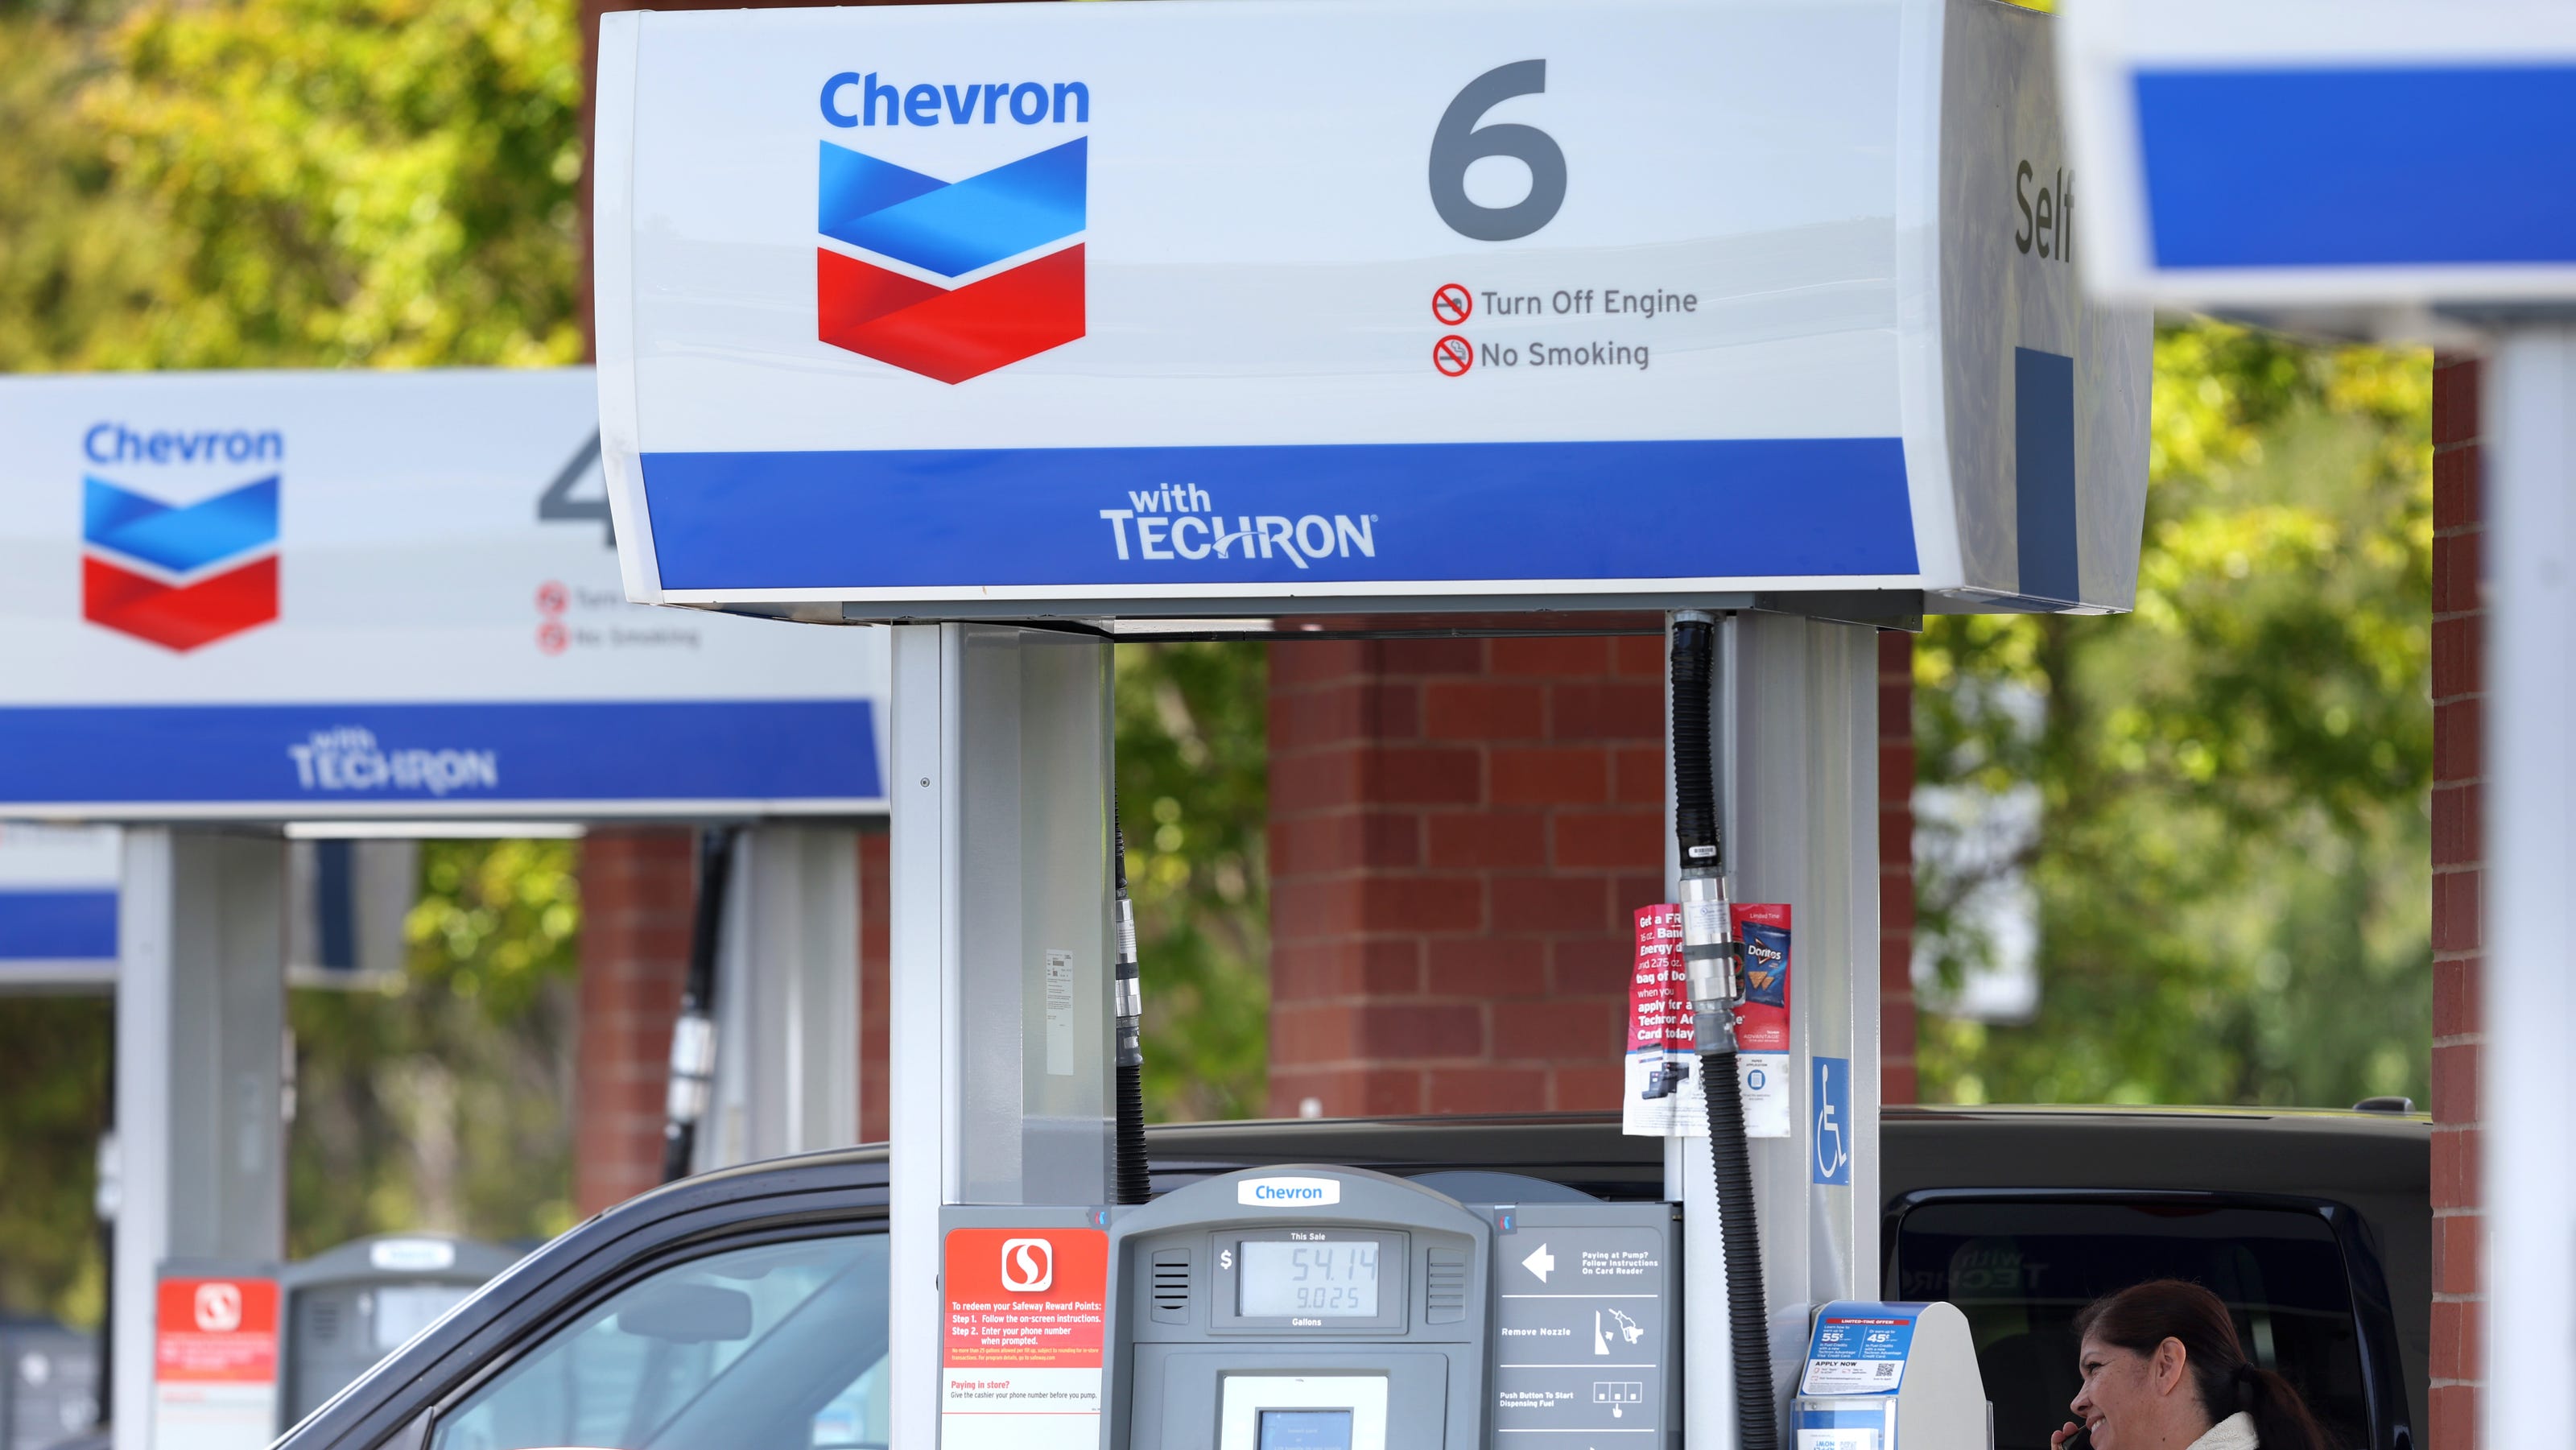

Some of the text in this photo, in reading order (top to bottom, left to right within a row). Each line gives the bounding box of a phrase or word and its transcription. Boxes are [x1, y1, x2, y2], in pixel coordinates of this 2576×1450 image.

[819, 71, 1089, 128] Chevron
[1429, 59, 1567, 242] 6
[2015, 159, 2076, 263] Self
[1481, 289, 1698, 318] Turn Off Engine
[1481, 341, 1649, 370] No Smoking
[82, 421, 284, 466] Chevron
[1128, 483, 1212, 513] with
[312, 725, 376, 751] with
[290, 745, 498, 796] TECHRON
[1640, 915, 1652, 927] Get
[1654, 915, 1662, 924] a
[1640, 944, 1673, 957] Energy
[1748, 945, 1781, 960] Doritos
[1651, 957, 1670, 969] 2.75
[1636, 973, 1655, 985] bag
[1657, 971, 1669, 981] of
[1637, 988, 1674, 998] when you
[1638, 999, 1666, 1014] apply
[1686, 1001, 1692, 1010] a
[1637, 1027, 1662, 1040] Card
[1256, 1185, 1323, 1199] Chevron
[1291, 1233, 1326, 1241] This Sale
[1220, 1249, 1232, 1270] $
[1582, 1251, 1609, 1260] Paying
[1622, 1251, 1649, 1259] Pump?
[1291, 1248, 1379, 1282] 54.14
[1297, 1287, 1359, 1309] 9.025
[952, 1302, 1102, 1313] To redeem your Safeway Reward Points:
[952, 1314, 1101, 1324] Step 1. Follow the on-screen instructions.
[1292, 1318, 1322, 1327] Gallons
[952, 1327, 1071, 1337] Step 2. Enter your phone number
[1501, 1328, 1571, 1336] Remove Nozzle
[981, 1337, 1038, 1346] when prompted.
[951, 1381, 1010, 1390] Paying in store?
[1500, 1391, 1517, 1399] Push
[1519, 1391, 1544, 1399] Button
[1500, 1399, 1538, 1408] Dispensing
